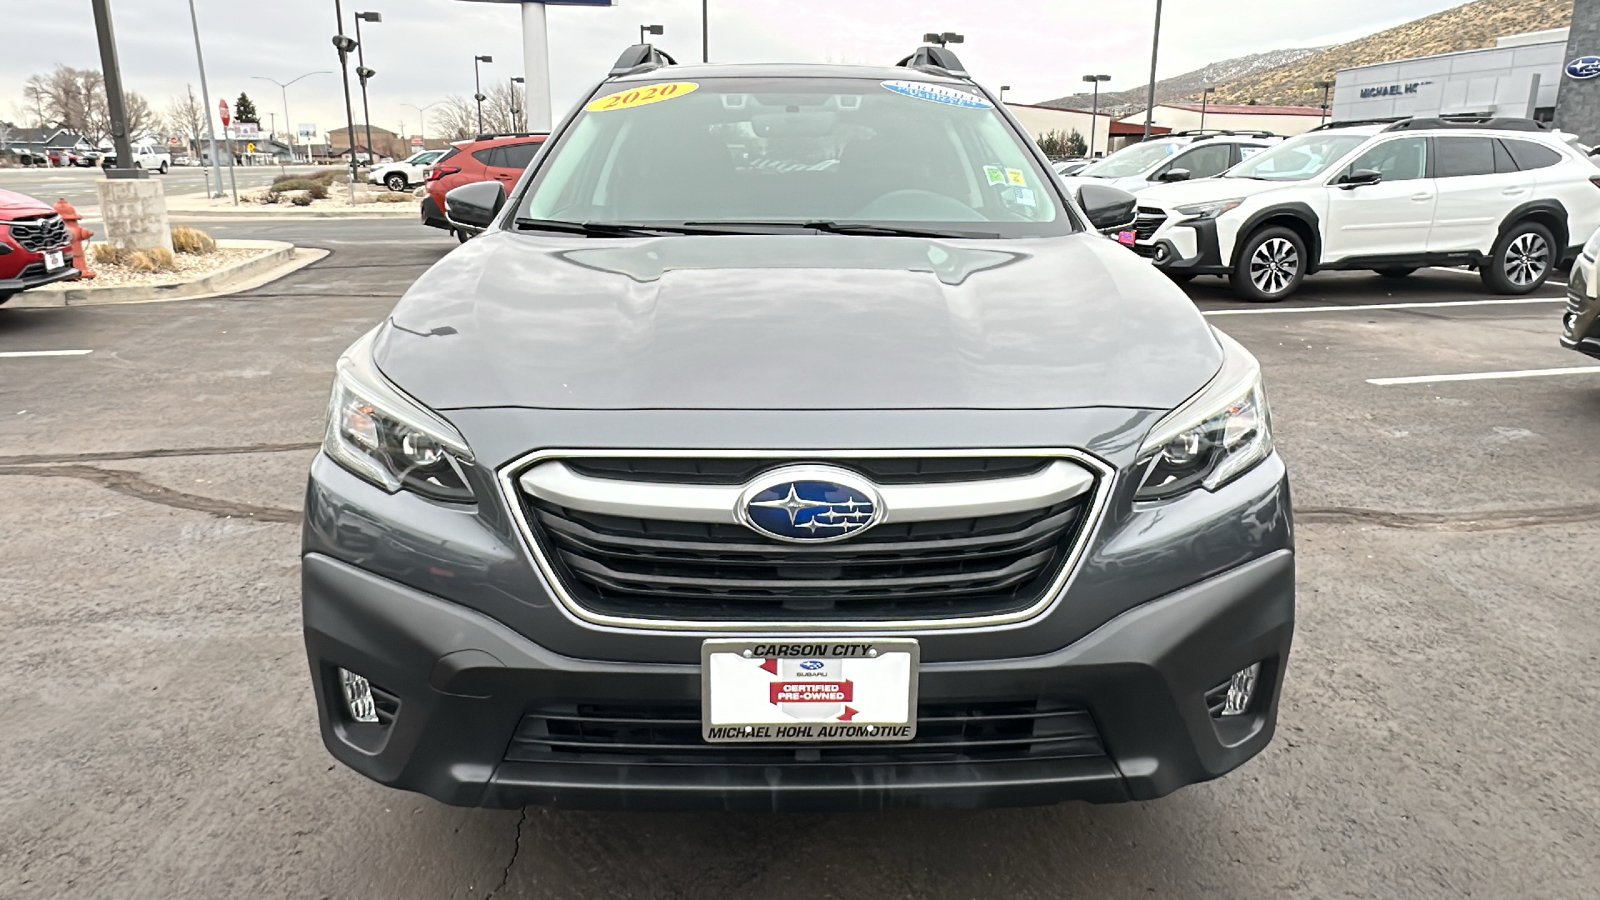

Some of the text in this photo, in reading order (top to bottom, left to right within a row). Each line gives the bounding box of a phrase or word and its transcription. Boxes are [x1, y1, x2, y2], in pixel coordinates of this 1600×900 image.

[603, 84, 677, 109] 2020
[1360, 85, 1403, 98] MICHAEL
[753, 644, 872, 656] CARSON CITY
[783, 684, 840, 692] CERTIFIED
[778, 692, 845, 700] PRE-OWNED
[708, 726, 910, 738] MICHAEL HOHL AUTOMOTIVE
